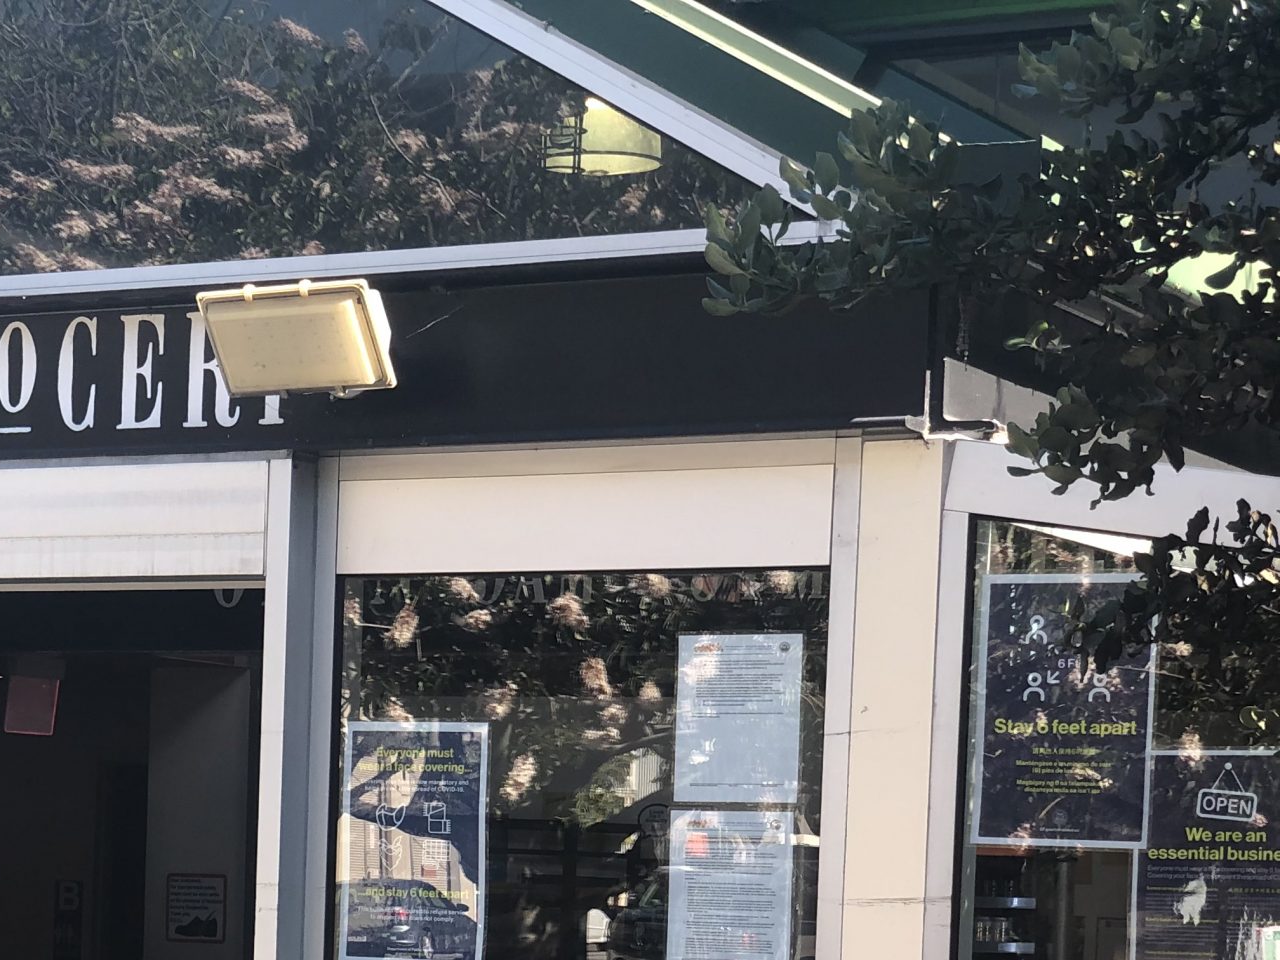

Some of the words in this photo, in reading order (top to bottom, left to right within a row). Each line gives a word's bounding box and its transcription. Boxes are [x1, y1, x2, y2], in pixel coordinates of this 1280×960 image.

[994, 718, 1034, 737] Stay
[1037, 719, 1049, 735] 6
[1052, 719, 1086, 735] feet
[1089, 720, 1137, 738] apart
[427, 747, 454, 758] must
[1202, 796, 1252, 815] OPEN
[1185, 827, 1212, 842] We
[1215, 831, 1243, 842] are
[1245, 831, 1267, 842] an
[1147, 846, 1225, 861] essential
[387, 888, 408, 898] stay
[410, 887, 417, 897] 6
[419, 888, 439, 898] feet
